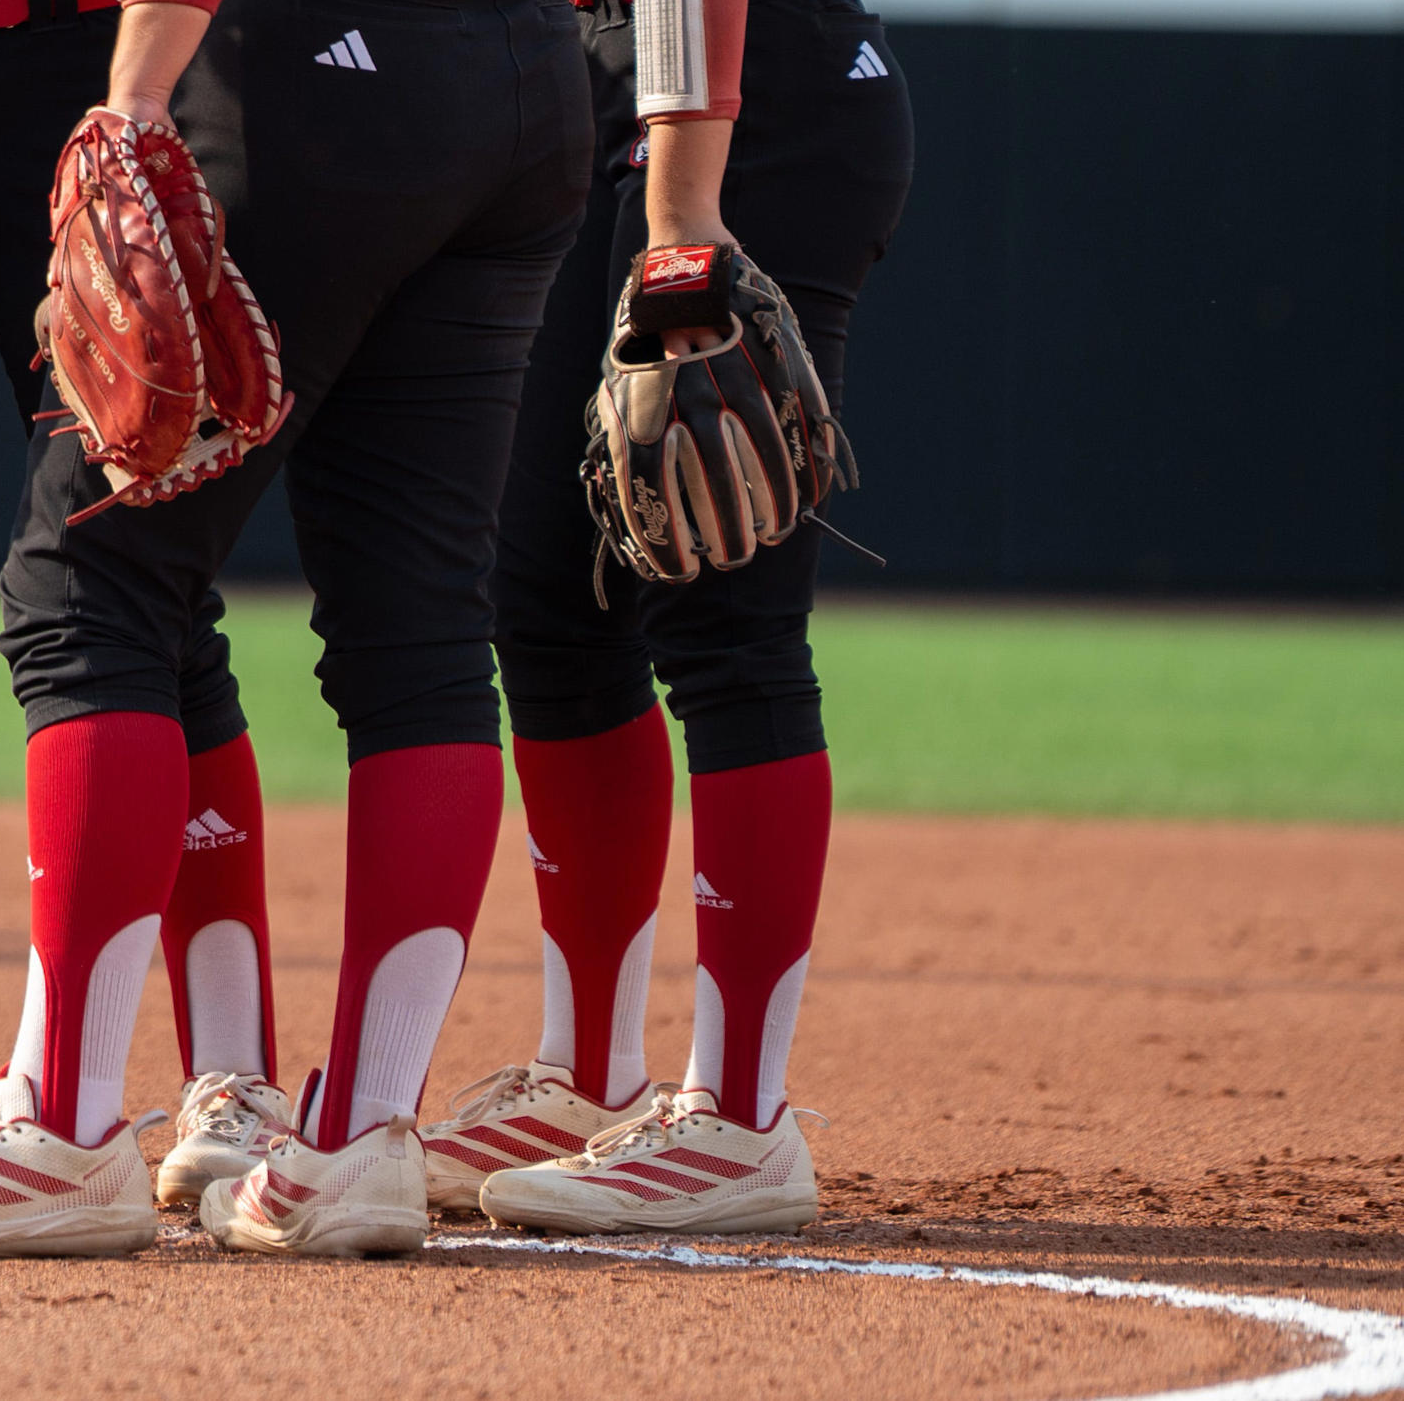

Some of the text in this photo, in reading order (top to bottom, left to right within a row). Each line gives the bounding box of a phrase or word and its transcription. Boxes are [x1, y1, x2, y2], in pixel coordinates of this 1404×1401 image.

[80, 238, 131, 332] Rawlings
[86, 341, 117, 385] SOUTH
[633, 475, 669, 546] Rawlings
